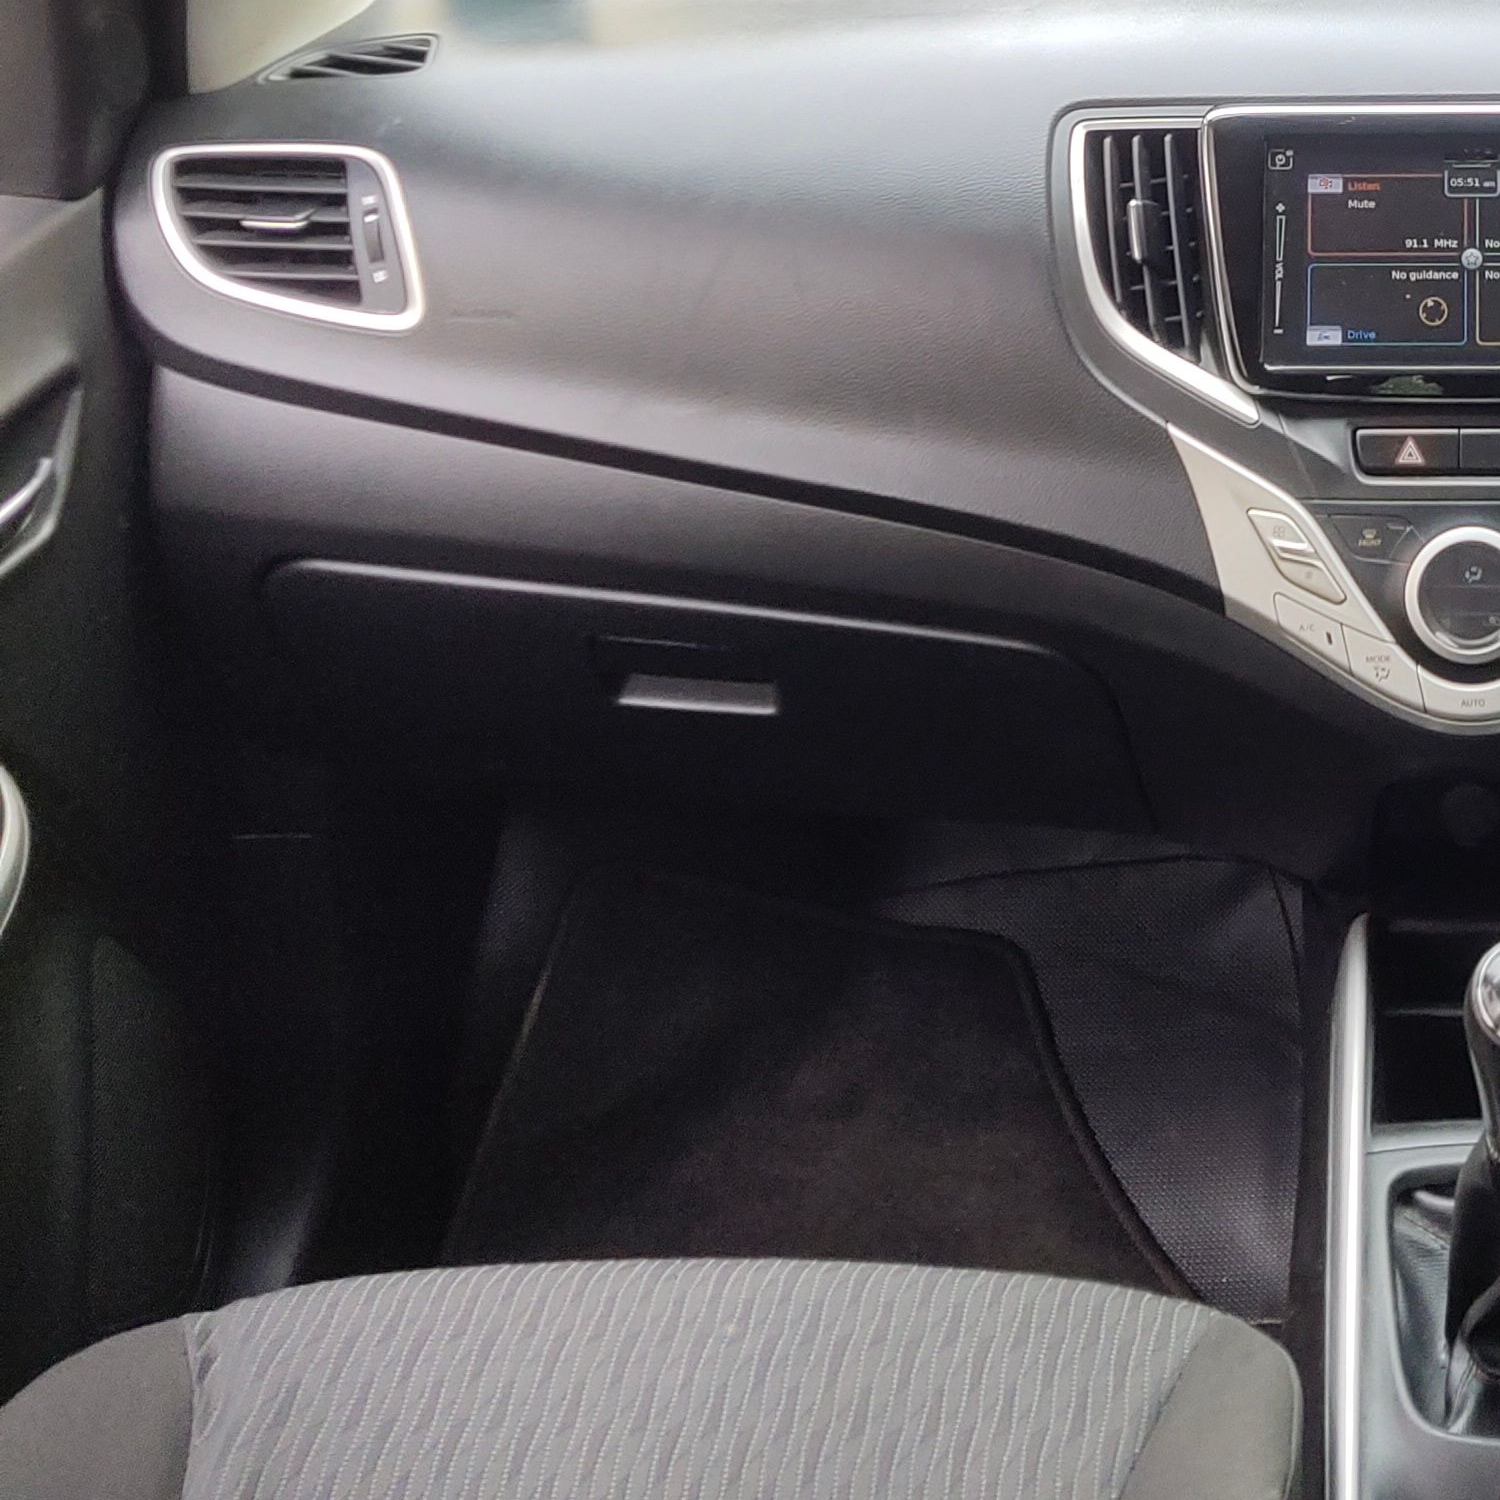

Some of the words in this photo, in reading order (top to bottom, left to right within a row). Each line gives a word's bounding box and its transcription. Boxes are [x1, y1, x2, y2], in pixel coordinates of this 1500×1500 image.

[1347, 181, 1381, 191] Listen
[1450, 178, 1480, 187] 05:51
[1347, 199, 1376, 209] Mute
[1405, 239, 1428, 248] 91.1
[1434, 239, 1458, 248] MHz
[1485, 239, 1500, 248] No
[1275, 262, 1285, 281] VOL
[1391, 270, 1408, 280] No
[1409, 270, 1459, 282] guidance
[1485, 270, 1500, 280] No
[1347, 330, 1376, 339] Drive
[1365, 655, 1391, 663] MODE
[1460, 699, 1486, 708] AUTO
